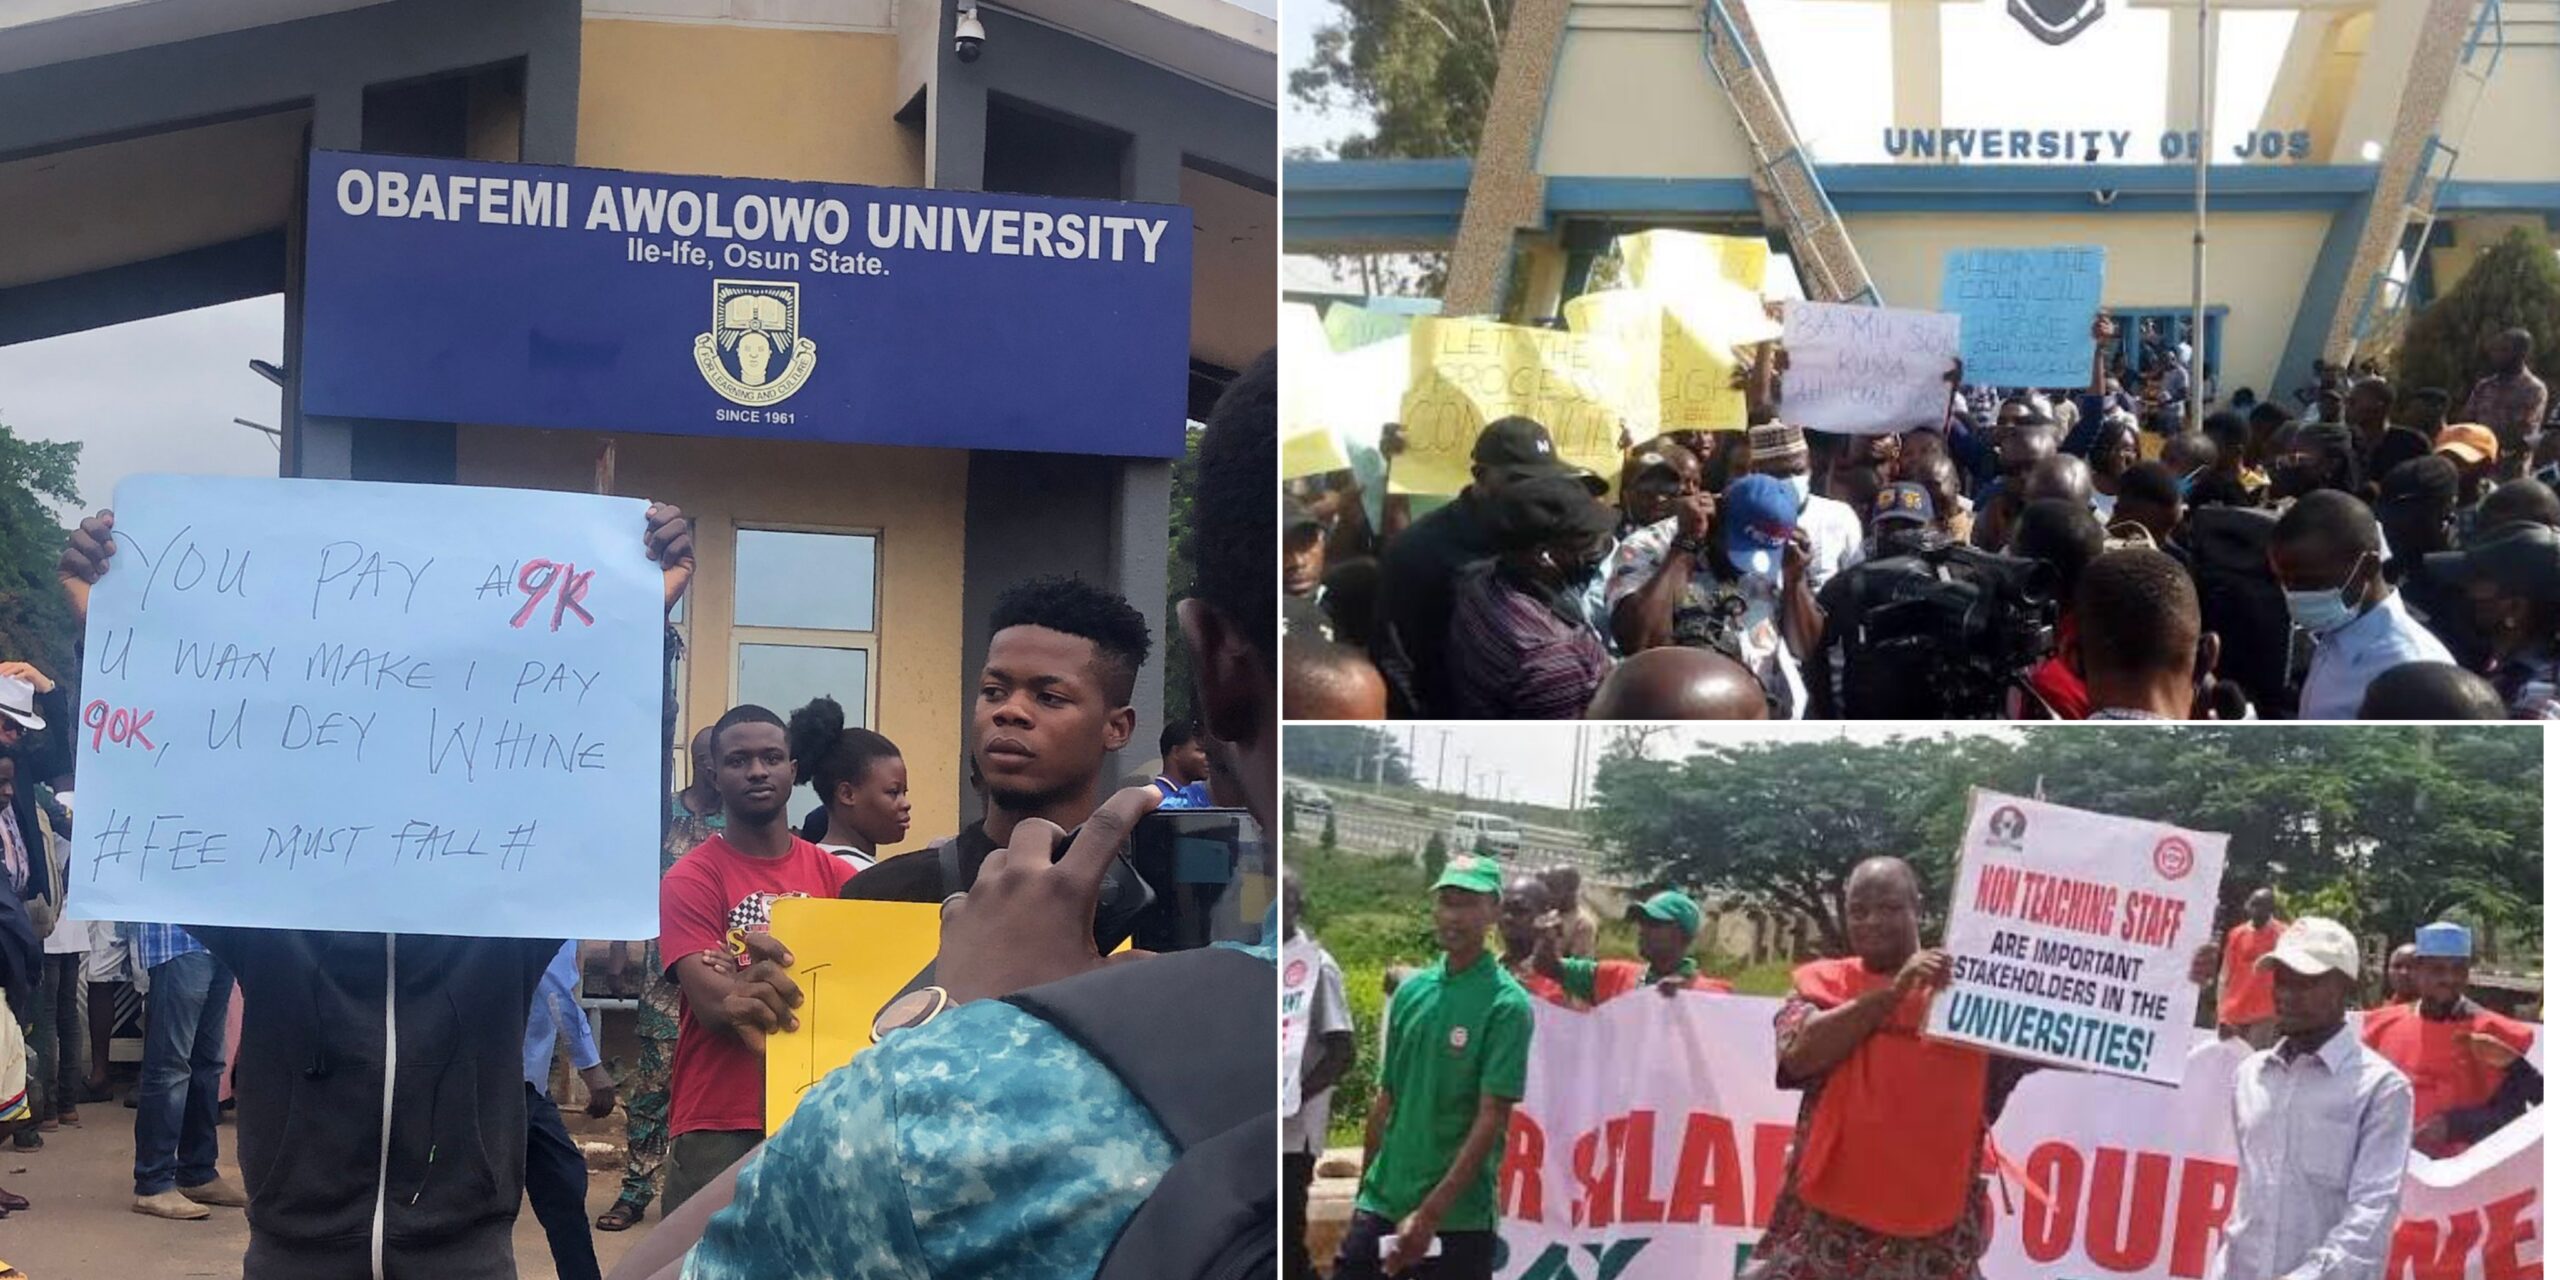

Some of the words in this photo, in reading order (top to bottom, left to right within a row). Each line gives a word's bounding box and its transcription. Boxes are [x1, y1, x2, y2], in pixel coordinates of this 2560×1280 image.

[1883, 127, 2131, 160] UNIVERSITY
[2233, 131, 2312, 158] JOS
[337, 168, 570, 228] OBAFEMI
[585, 184, 850, 246] AWOLOWO
[867, 202, 1168, 264] UNIVERSITY
[628, 237, 715, 271] Ile-Ife,
[723, 243, 799, 271] Osun
[809, 247, 890, 276] State.
[1443, 327, 1515, 356] LET
[701, 352, 715, 373] FOR
[712, 370, 755, 400] LEARNING
[756, 389, 777, 400] AND
[777, 358, 809, 394] CULTURE
[716, 408, 760, 423] SINCE
[764, 411, 795, 424] 1961
[111, 525, 251, 611] YOU
[312, 541, 434, 620] PAY
[99, 626, 134, 681] U
[174, 638, 276, 682] WAN
[307, 641, 436, 691] MAKE
[464, 660, 477, 692] I
[513, 660, 601, 707] PAY
[207, 698, 247, 750] U
[281, 704, 377, 763] DEY
[429, 707, 606, 783] WHINE
[258, 824, 375, 870] MUST
[1973, 864, 2022, 918] NON
[2020, 870, 2118, 936] TEACHING
[2121, 890, 2186, 948] STAFF
[1990, 930, 2031, 959] ARE
[2032, 938, 2144, 983] IMPORTANT
[1954, 955, 2097, 1007] STAKEHOLDERS
[2101, 984, 2125, 1013] IN
[2130, 989, 2169, 1021] THE
[1947, 991, 2156, 1073] UNIVERSITIES!
